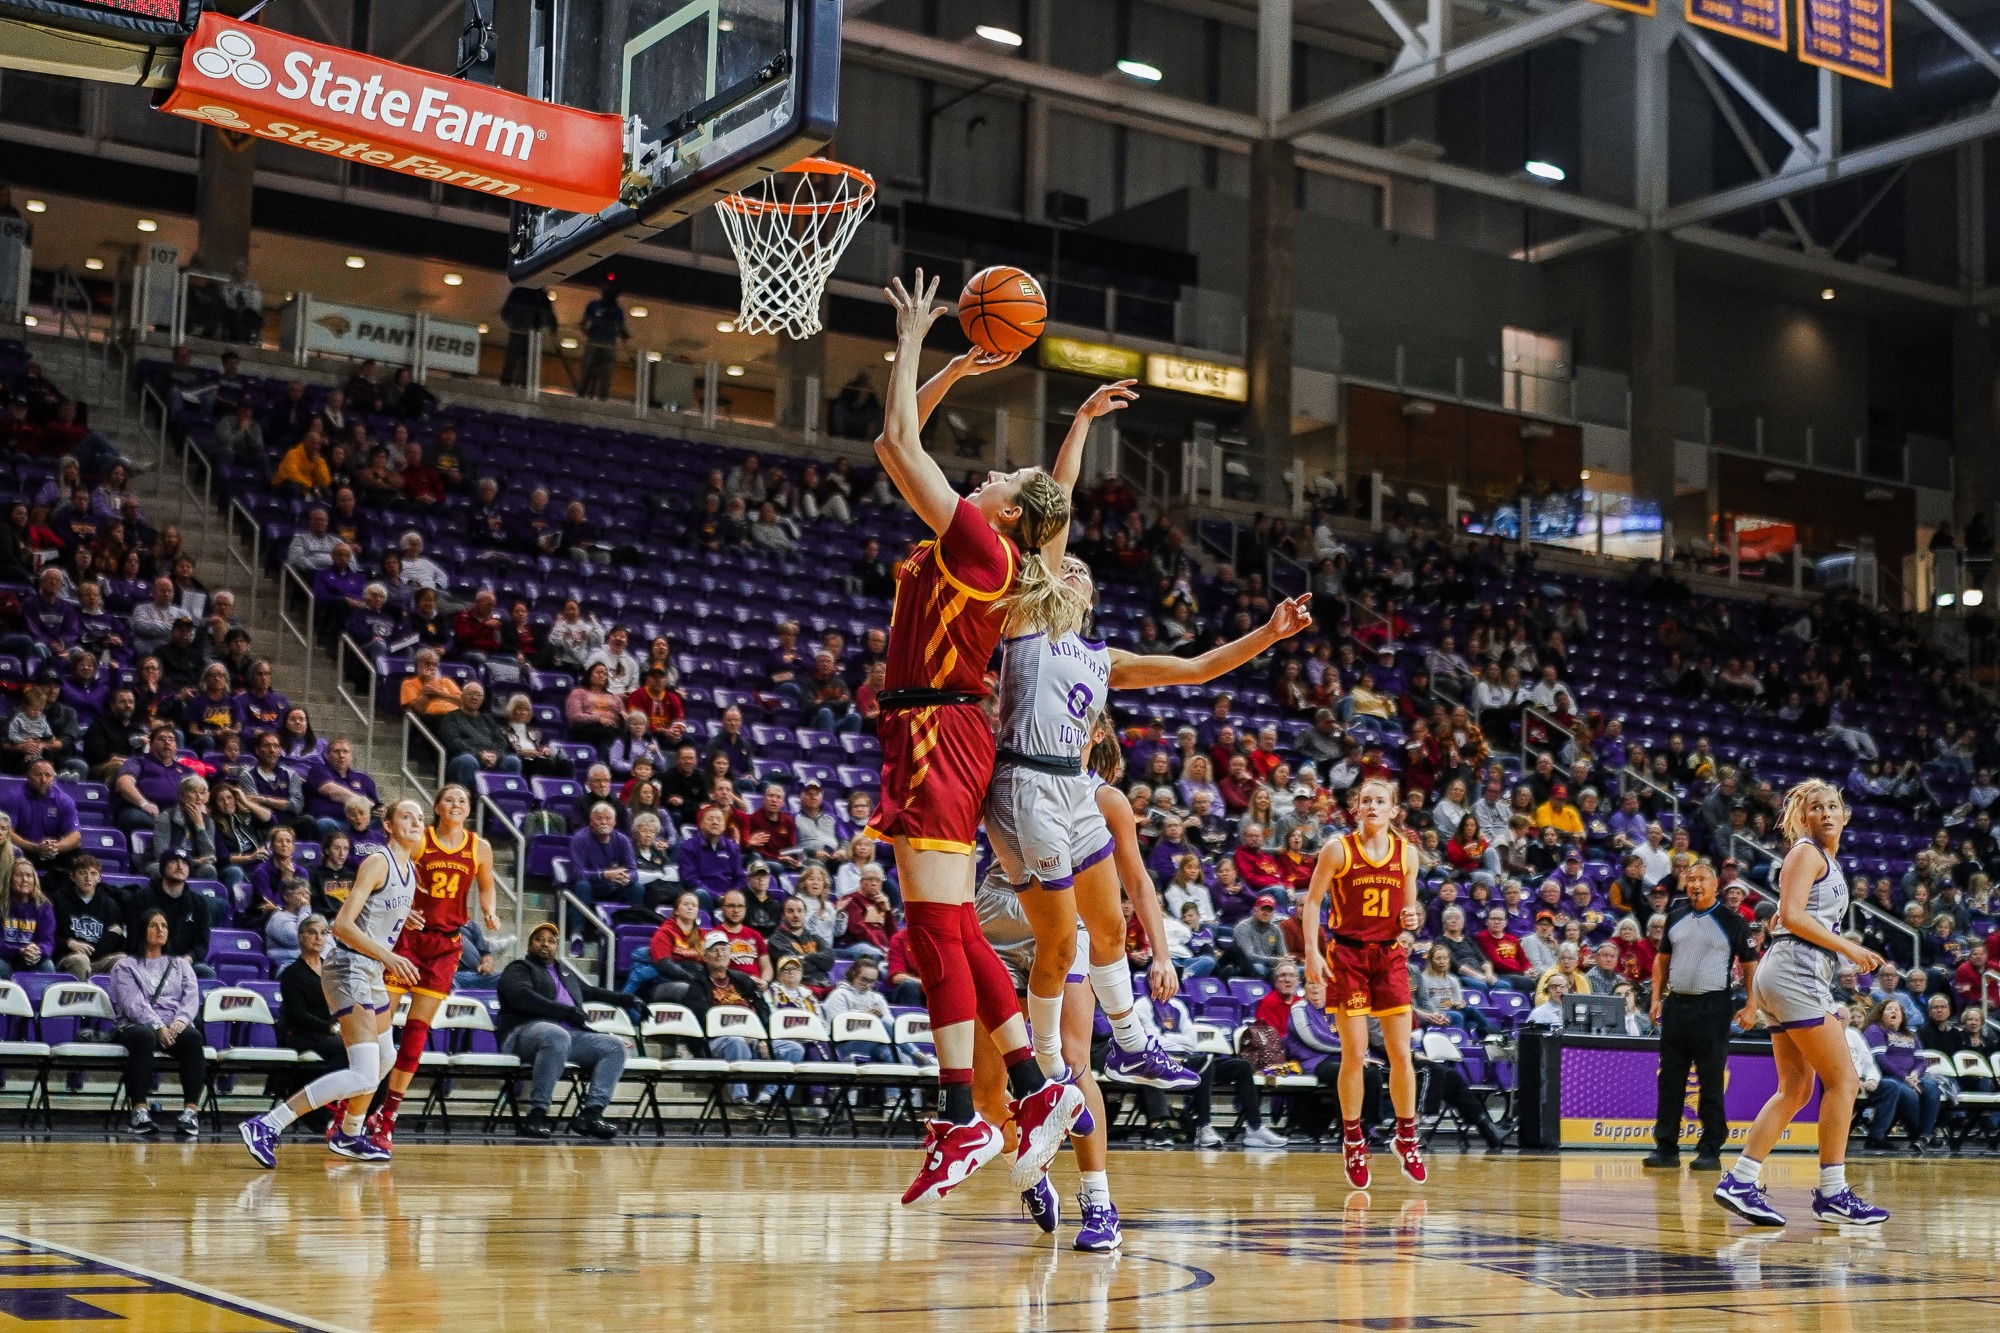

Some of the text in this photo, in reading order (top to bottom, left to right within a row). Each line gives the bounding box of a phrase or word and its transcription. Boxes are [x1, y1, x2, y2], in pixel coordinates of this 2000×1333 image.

[276, 50, 535, 161] State Farm
[254, 122, 521, 195] State Farm
[151, 246, 178, 265] 107
[1049, 641, 1109, 689] NORTHE
[1067, 682, 1094, 721] 0
[426, 861, 470, 875] IOWA STATE
[431, 871, 460, 899] 24
[1352, 876, 1401, 889] IOWA STATE
[1362, 888, 1390, 918] 21
[58, 990, 97, 1006] UNI
[220, 995, 255, 1011] UNI
[446, 1004, 477, 1019] UNI
[655, 1011, 683, 1025] UNI
[720, 1014, 748, 1028] UNI
[783, 1016, 810, 1029] UNI
[846, 1019, 872, 1032] UNI
